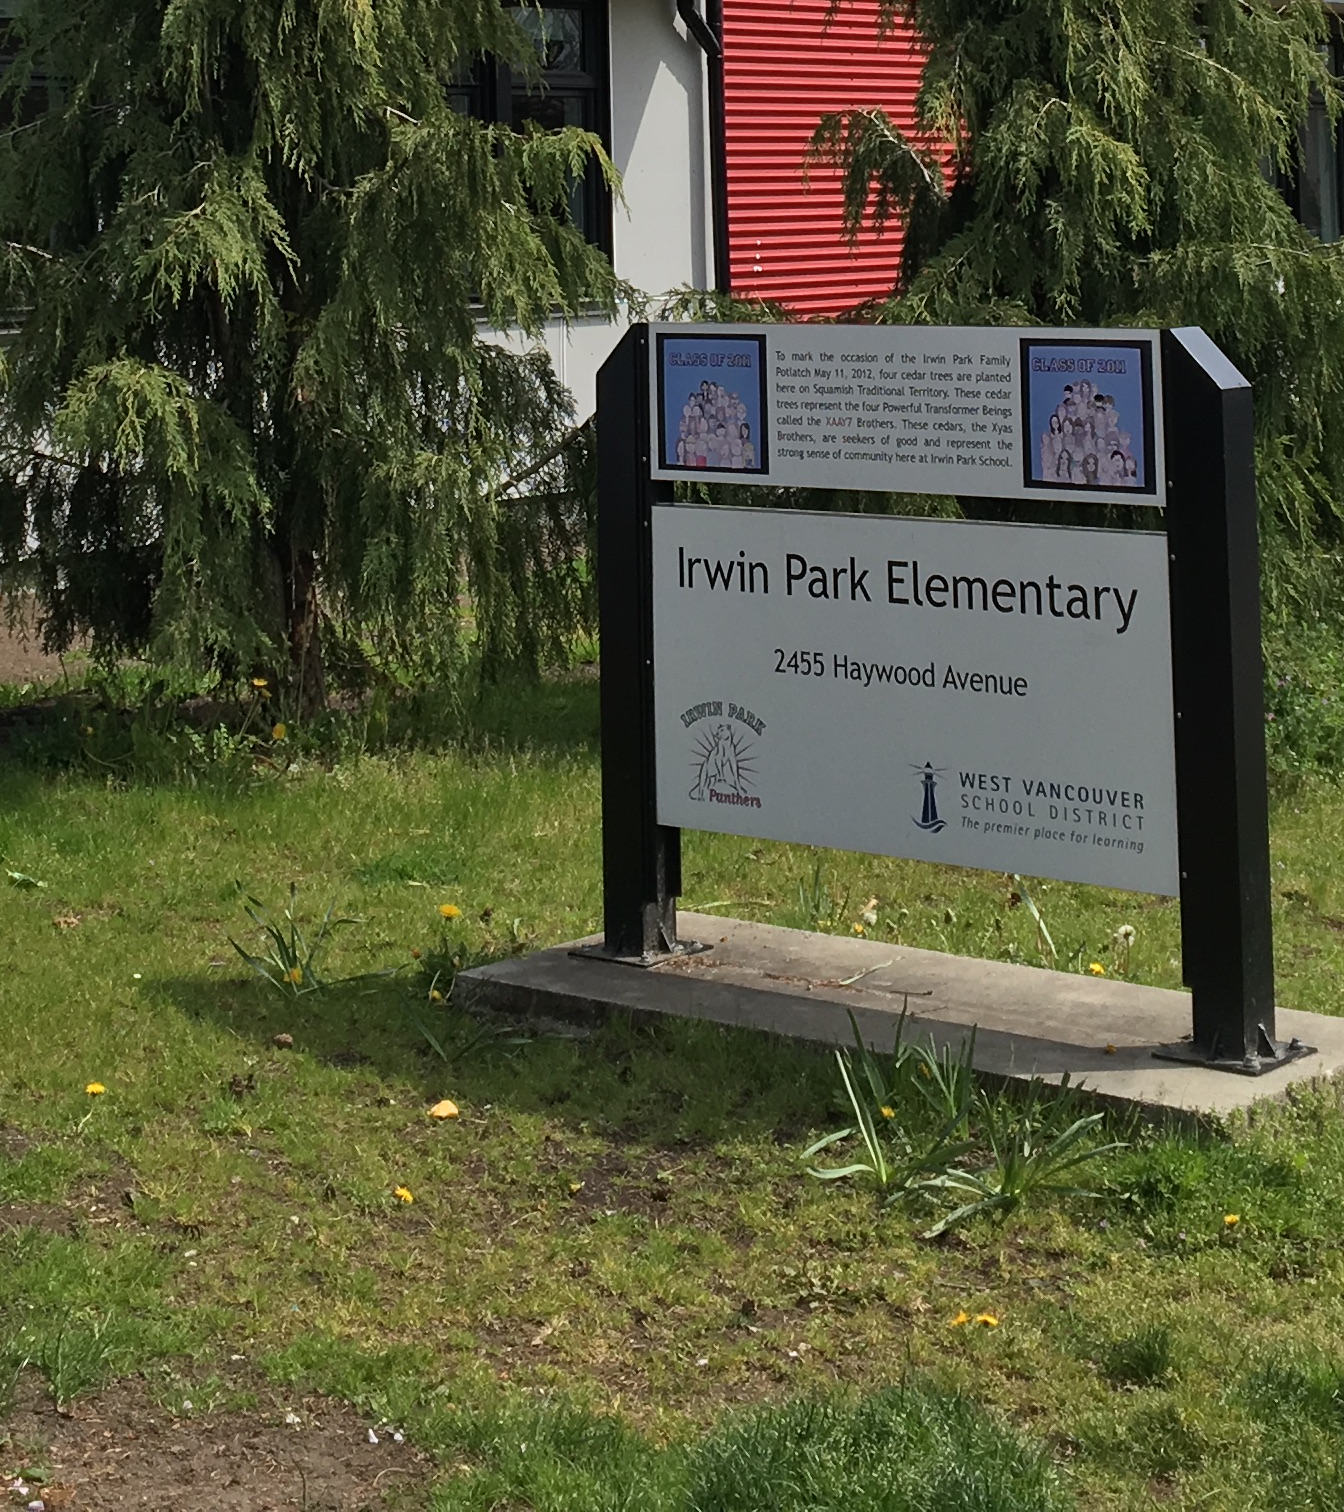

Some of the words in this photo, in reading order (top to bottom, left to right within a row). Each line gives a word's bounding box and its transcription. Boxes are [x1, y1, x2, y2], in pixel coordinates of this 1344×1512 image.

[669, 353, 707, 366] CLASS
[710, 353, 725, 367] OF
[776, 351, 785, 361] To
[792, 352, 813, 361] mark
[820, 352, 834, 362] the
[841, 353, 878, 362] occasion
[885, 353, 894, 363] of
[901, 353, 916, 364] the
[923, 354, 945, 364] Irwin
[953, 354, 973, 365] Park
[980, 355, 1011, 367] Family
[1032, 357, 1075, 372] CLASS
[1078, 359, 1095, 372] OF
[776, 367, 811, 377] Potlatch
[814, 369, 831, 379] May
[835, 369, 847, 379] 11,
[852, 369, 875, 380] 2012,
[879, 369, 897, 379] four
[901, 370, 926, 380] cedar
[930, 371, 953, 381] trees
[957, 373, 972, 381] are
[976, 372, 1011, 383] planted
[776, 383, 795, 393] here
[814, 384, 853, 395] Squamish
[857, 385, 904, 396] Traditional
[909, 387, 949, 399] Territory.
[954, 388, 981, 398] These
[985, 389, 1011, 399] cedar
[777, 401, 798, 409] trees
[801, 402, 842, 411] represent
[845, 401, 859, 411] the
[863, 401, 880, 411] four
[883, 403, 922, 413] Powerful
[925, 403, 979, 415] Transformer
[983, 405, 1012, 419] Beings
[777, 415, 802, 425] called
[807, 416, 821, 426] the
[902, 419, 928, 430] These
[933, 421, 966, 433] cedars,
[971, 422, 987, 432] the
[992, 423, 1012, 435] Xyas
[777, 431, 816, 443] Brothers,
[822, 434, 837, 442] are
[842, 434, 875, 444] seekers
[881, 435, 890, 445] of
[896, 437, 917, 447] good
[924, 437, 940, 447] and
[947, 440, 991, 449] represent
[998, 440, 1013, 450] the
[777, 448, 804, 460] strong
[807, 451, 830, 459] sense
[832, 449, 841, 459] of
[844, 451, 893, 463] community
[896, 452, 915, 463] here
[919, 454, 928, 463] at
[931, 454, 953, 464] Irwin
[957, 455, 976, 465] Park
[979, 456, 1012, 467] School.
[679, 546, 769, 594] Irwin
[786, 553, 871, 602] Park
[887, 560, 1138, 634] Elementary
[774, 648, 824, 677] 2455
[834, 654, 935, 688] Haywood
[942, 664, 1027, 696] Avenue
[680, 701, 722, 728] IRWIN
[728, 703, 766, 736] PARK
[709, 788, 761, 808] Panthers
[959, 772, 1011, 792] WEST
[1022, 779, 1144, 809] VANCOUVER
[961, 794, 1035, 817] SCHOOL
[1050, 805, 1144, 830] DISTRICT
[961, 816, 979, 830] The
[984, 821, 1030, 835] premier
[1034, 827, 1065, 841] place
[1070, 831, 1087, 844] for
[1093, 834, 1144, 854] learning
